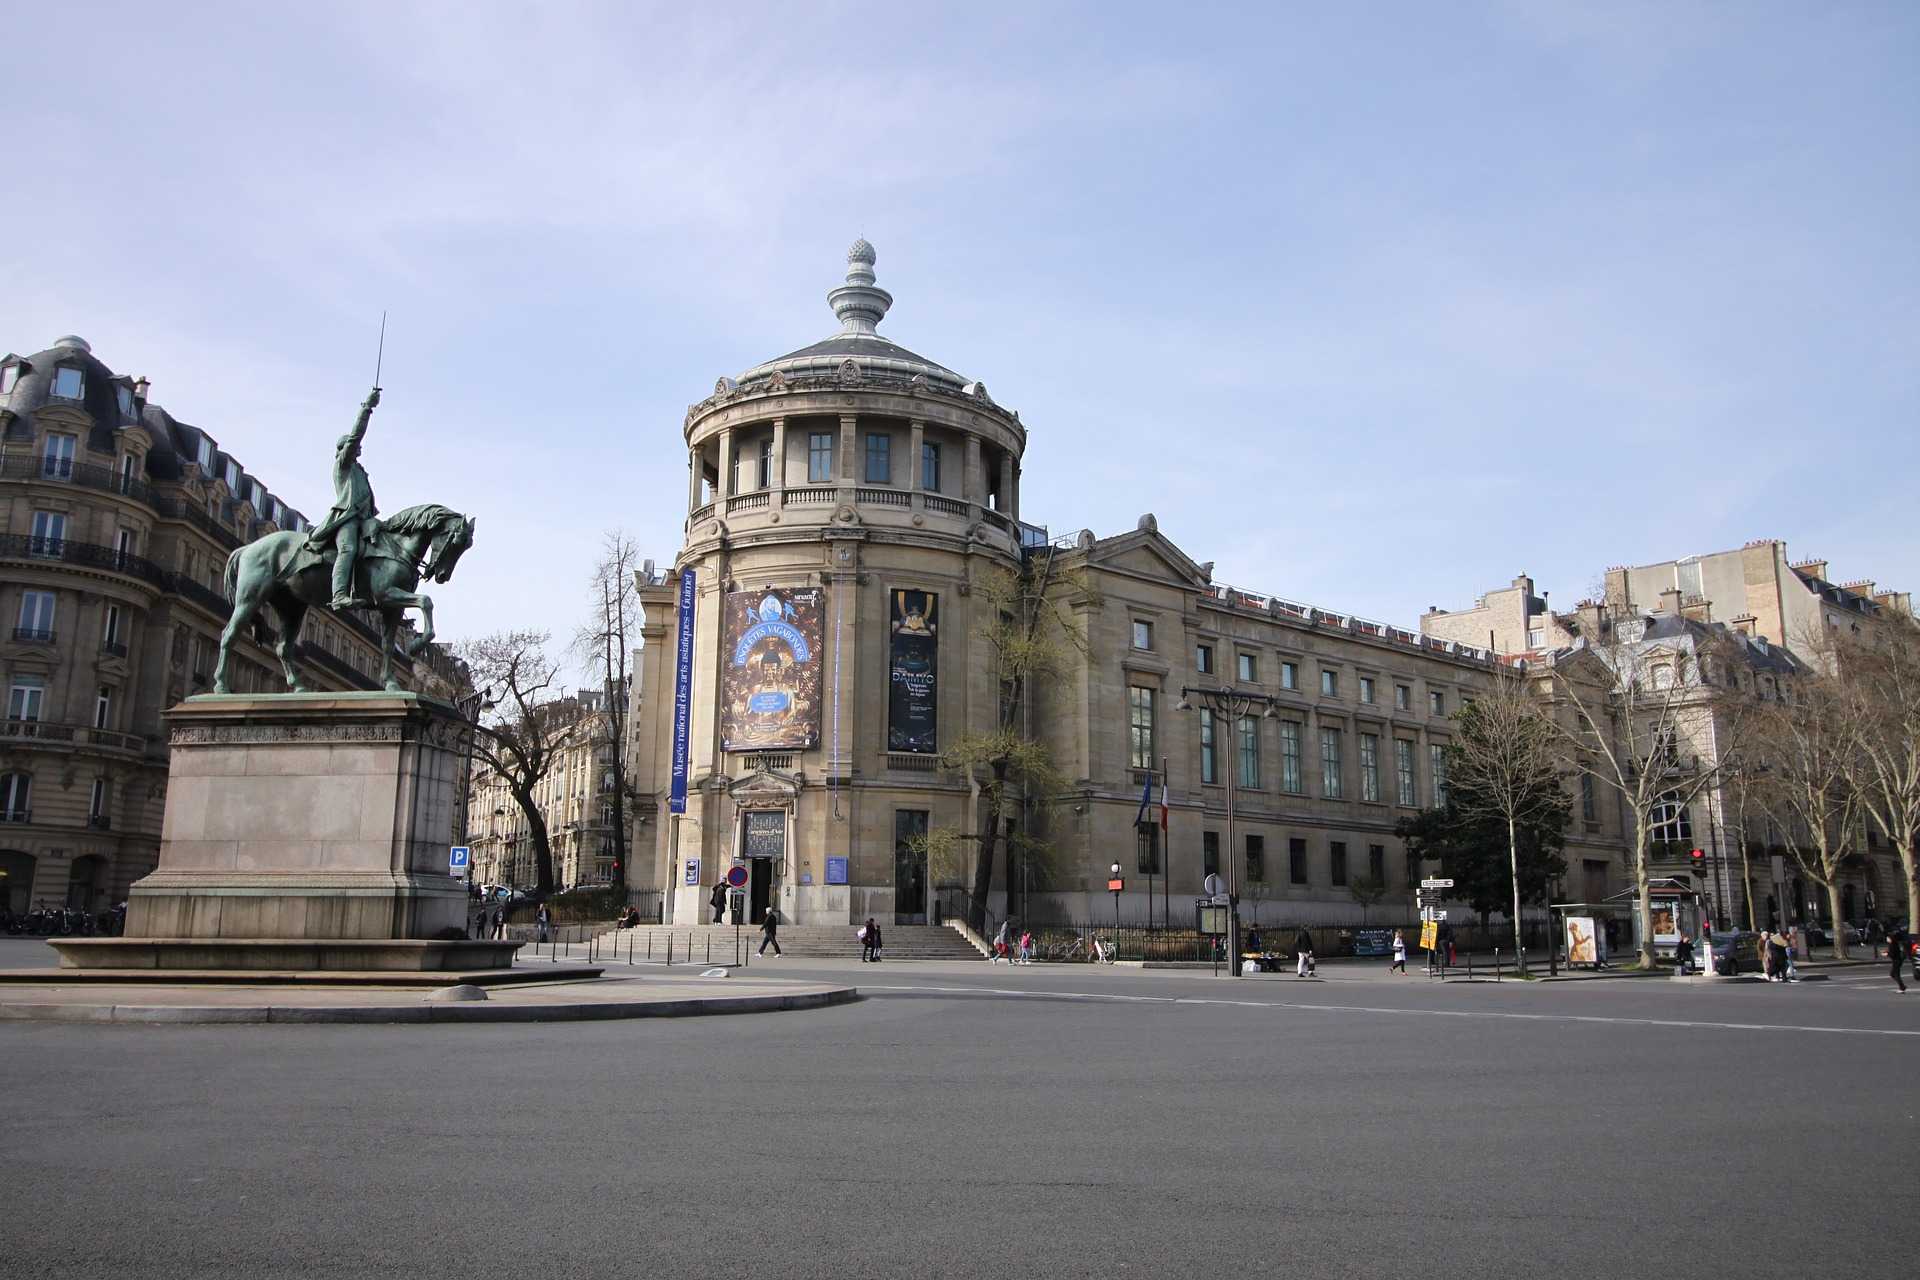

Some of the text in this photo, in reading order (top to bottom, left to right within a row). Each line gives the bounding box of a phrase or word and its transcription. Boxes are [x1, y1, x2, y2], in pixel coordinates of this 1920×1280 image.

[680, 664, 688, 683] arts
[677, 685, 688, 702] des
[676, 703, 687, 741] national
[673, 743, 685, 777] Musée
[455, 851, 464, 864] P
